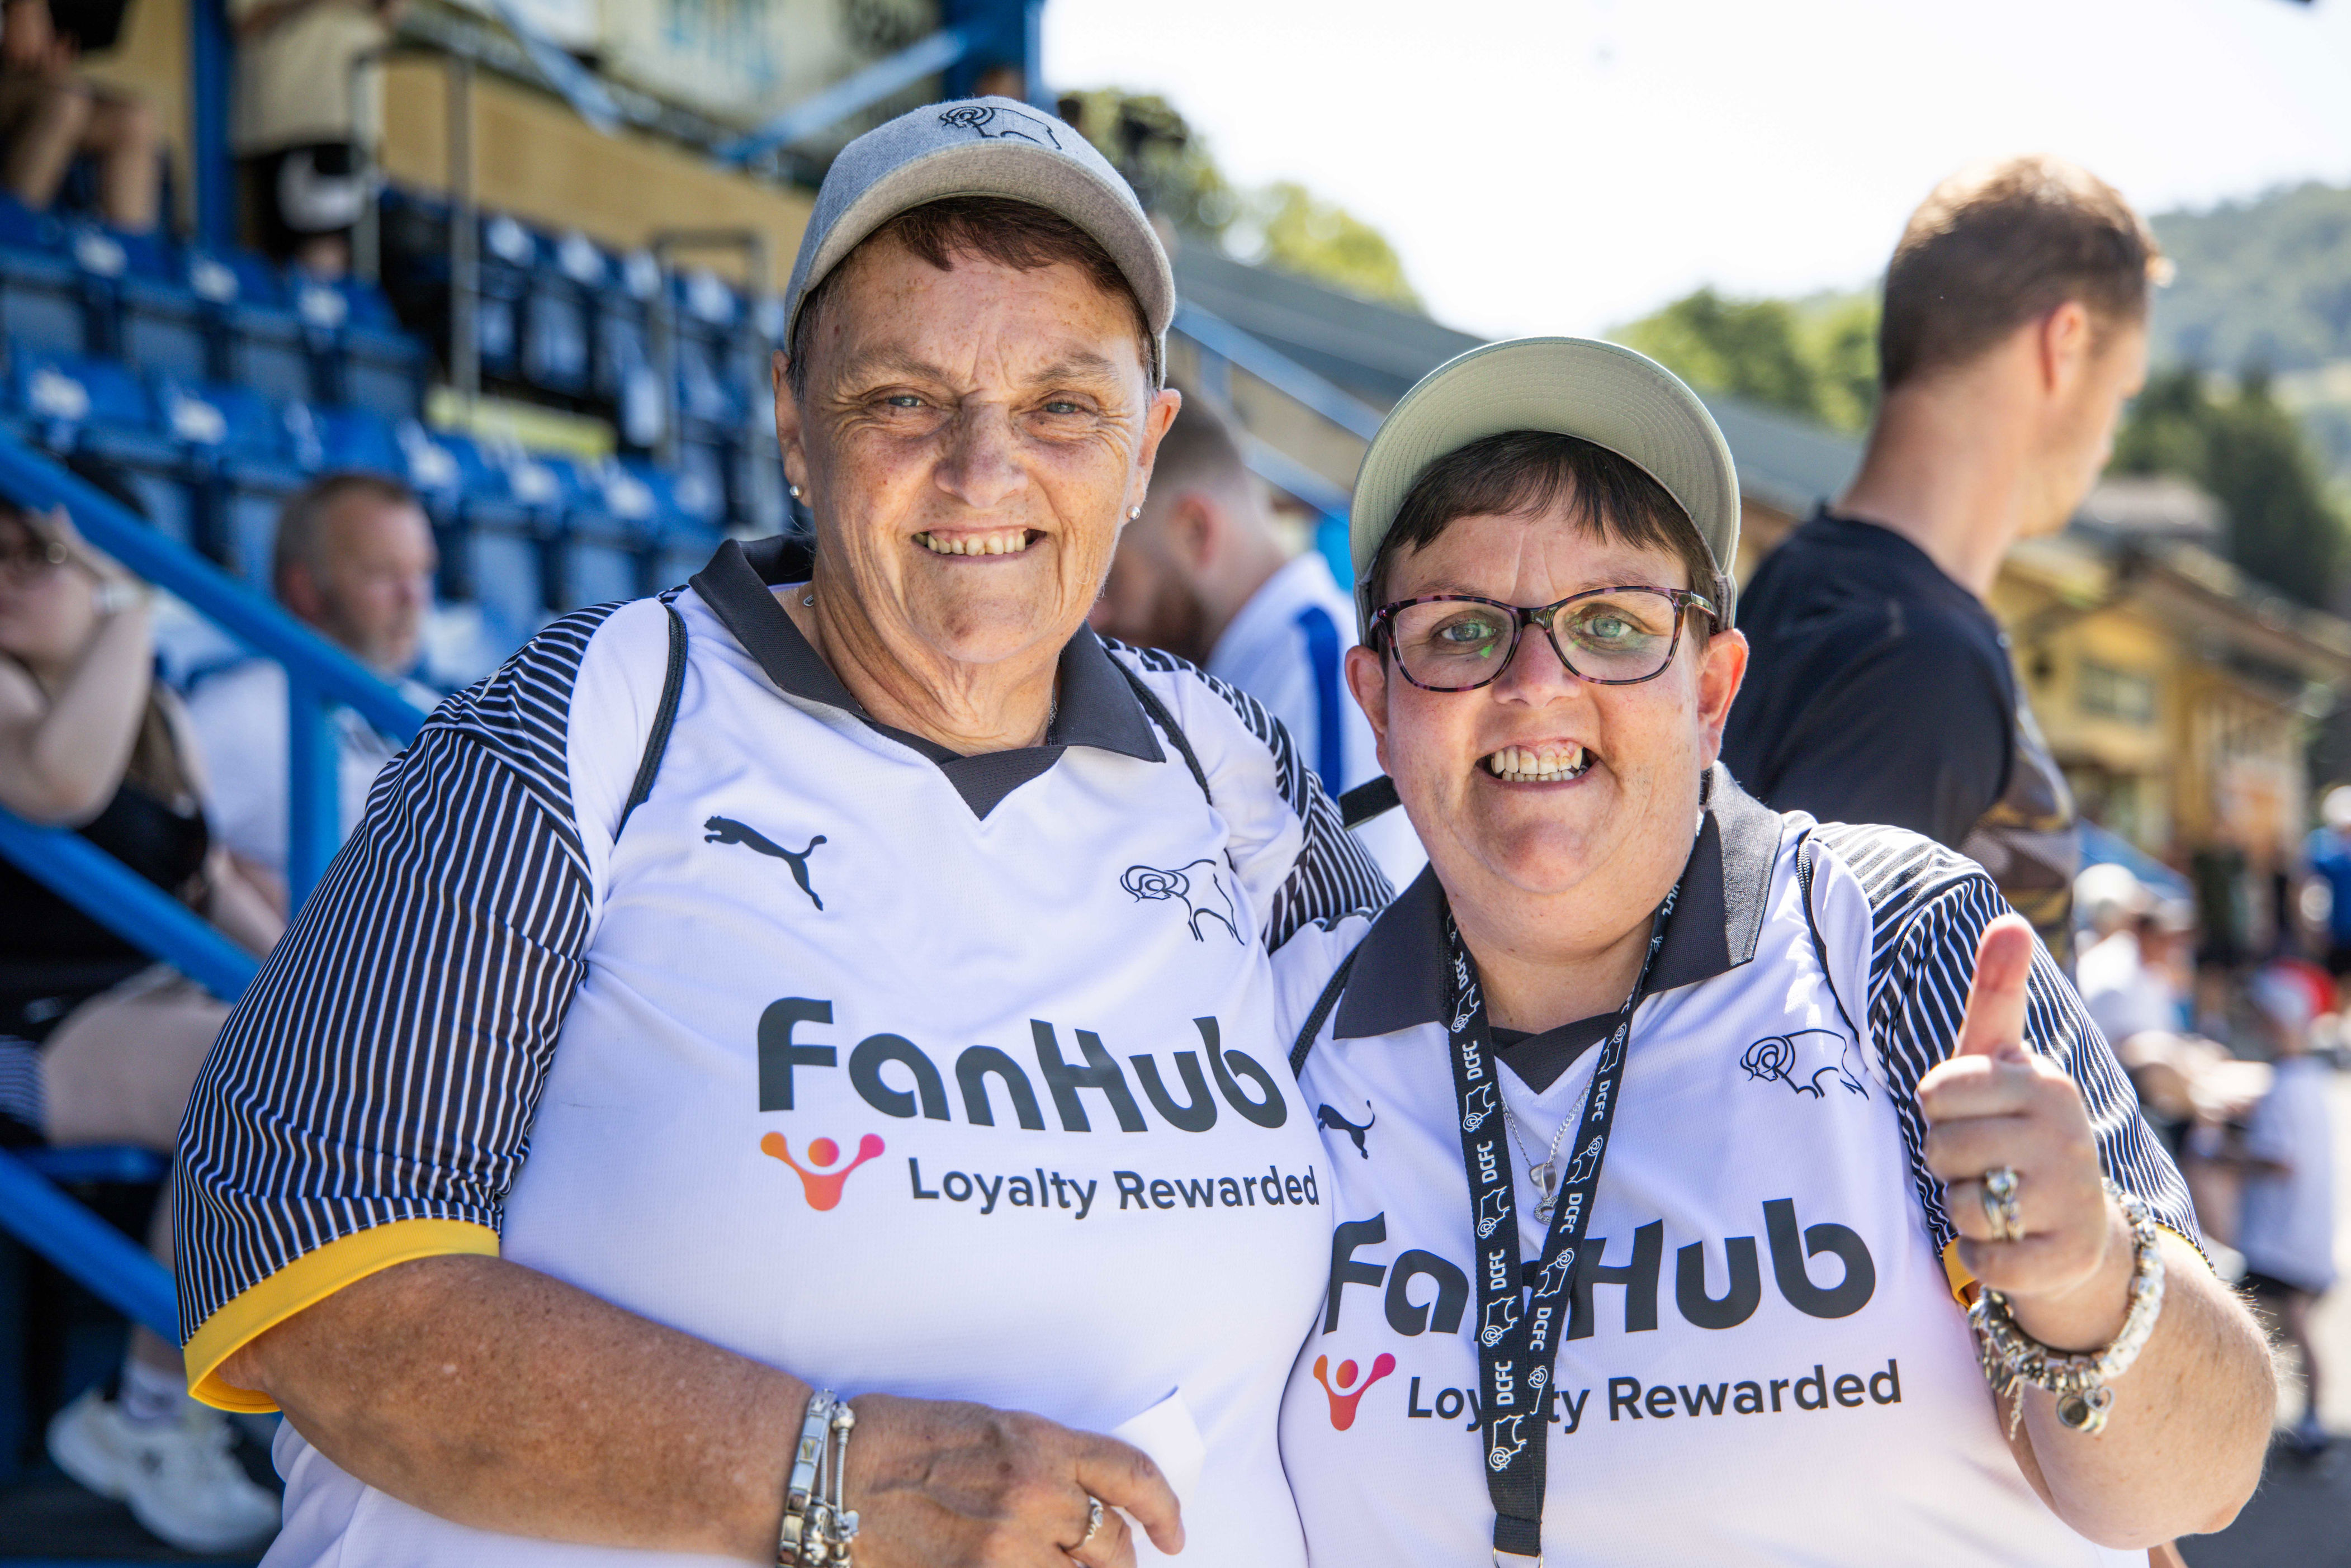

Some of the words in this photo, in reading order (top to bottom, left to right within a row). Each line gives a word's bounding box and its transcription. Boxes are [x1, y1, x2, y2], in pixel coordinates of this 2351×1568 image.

[1454, 951, 1469, 990] DCFC
[758, 997, 1287, 1133] FanHub
[1461, 1040, 1483, 1081] DCFC
[1591, 1079, 1611, 1121] DCFC
[1477, 1140, 1498, 1183] DCFC
[909, 1158, 1096, 1220] Loyalty
[1114, 1166, 1320, 1209] Rewarded
[1559, 1192, 1583, 1234] DCFC
[1322, 1197, 1876, 1342] FaHub
[1488, 1249, 1507, 1290] DCFC
[1529, 1307, 1552, 1351] DCFC
[1408, 1376, 1591, 1434] Loyty
[1608, 1358, 1901, 1421] Rewarded
[1494, 1360, 1515, 1405] DCFC
